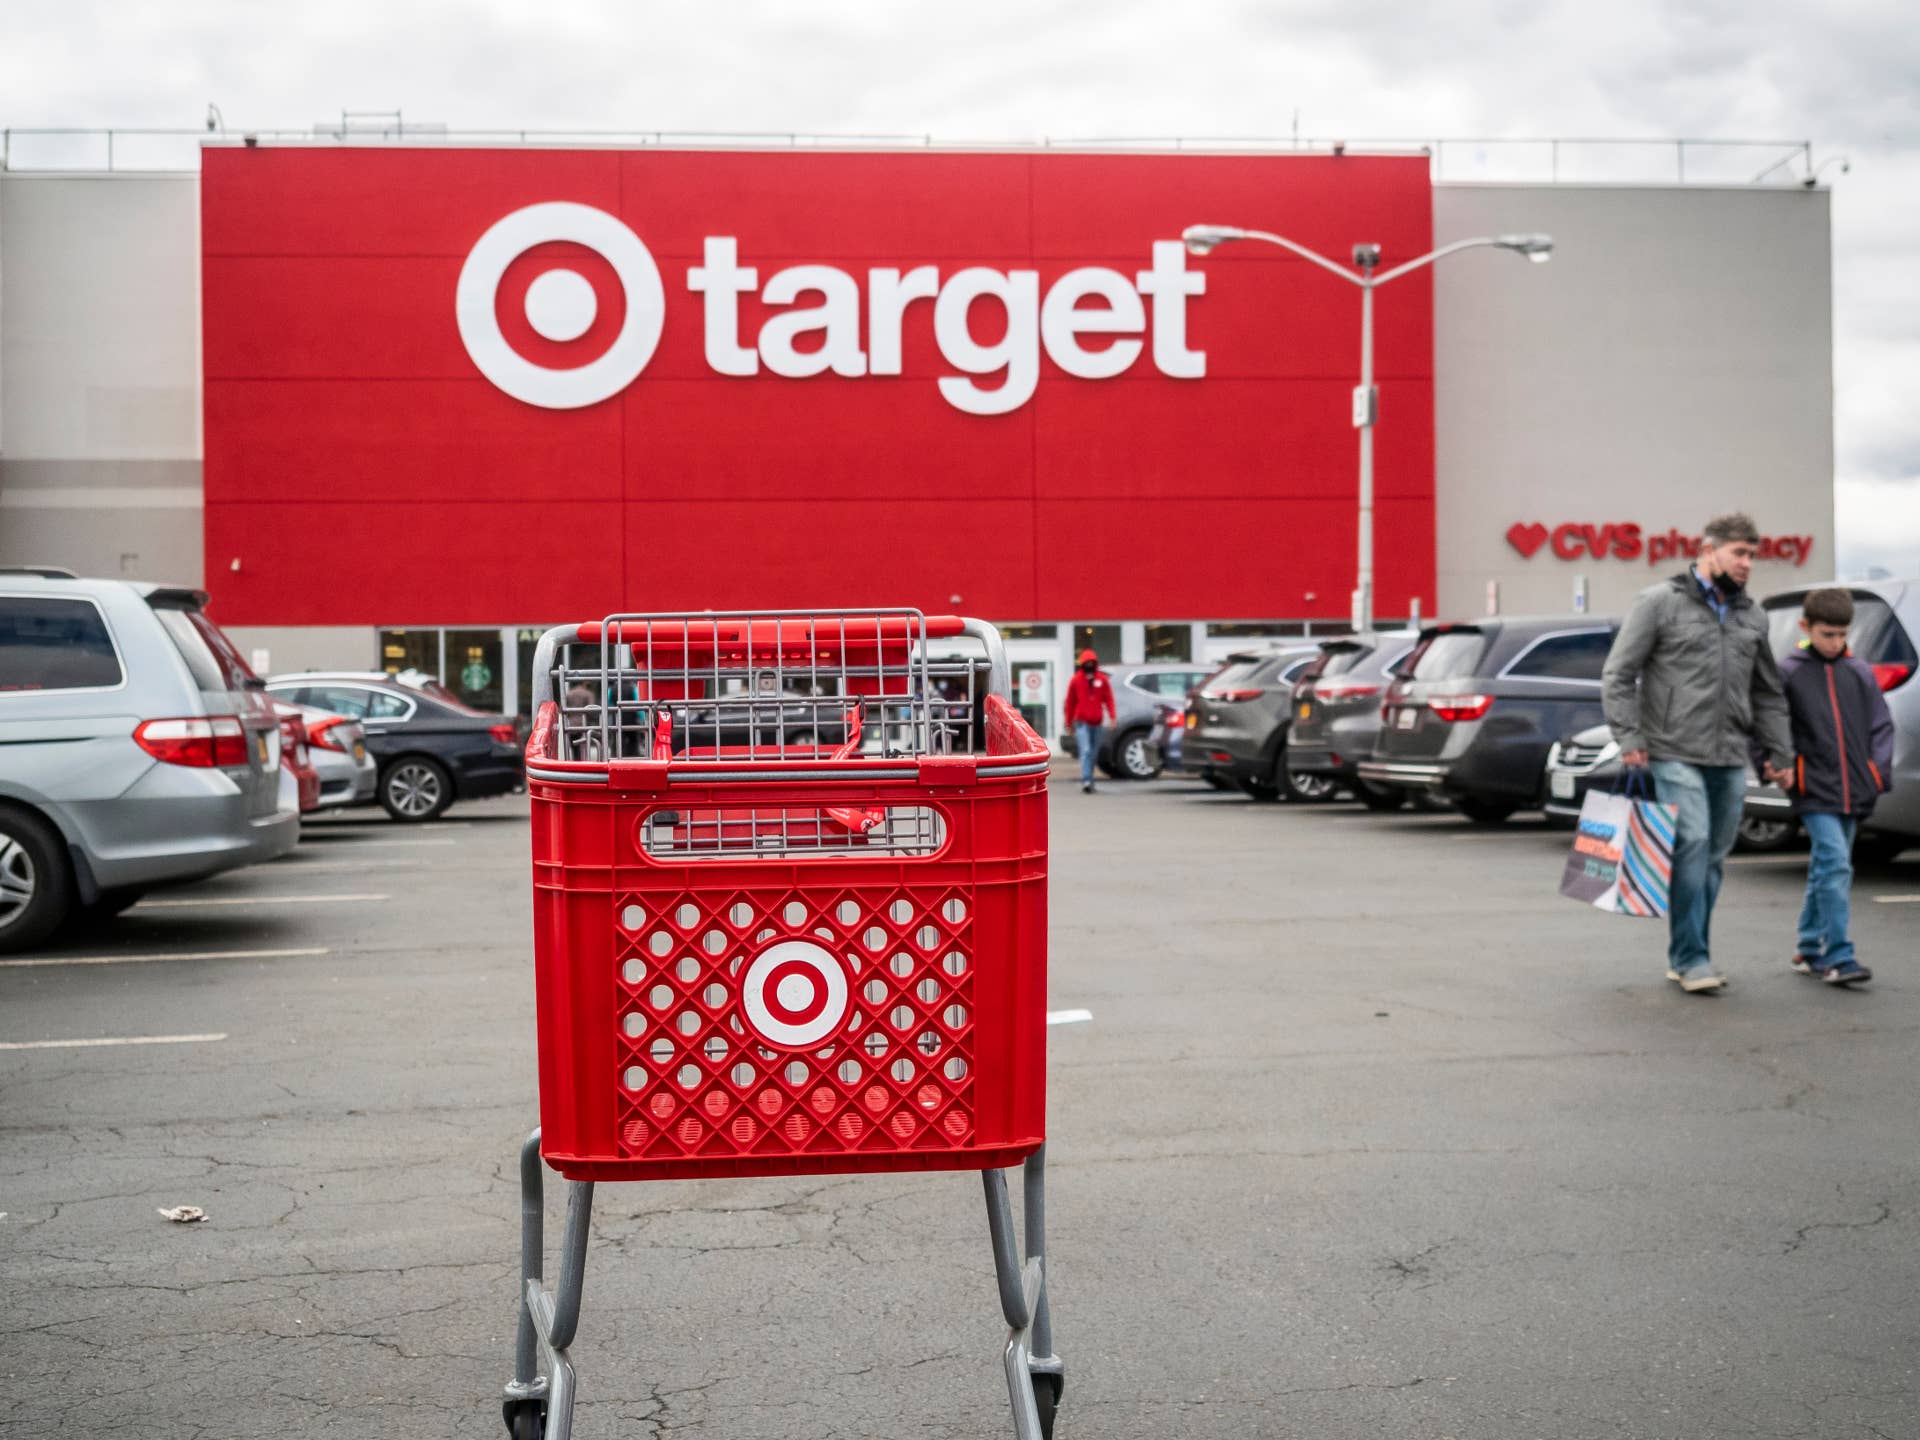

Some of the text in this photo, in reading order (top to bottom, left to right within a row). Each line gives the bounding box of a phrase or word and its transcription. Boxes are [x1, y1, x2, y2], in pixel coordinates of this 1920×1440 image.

[687, 236, 1207, 415] target
[1551, 522, 1814, 566] CVS phaacy
